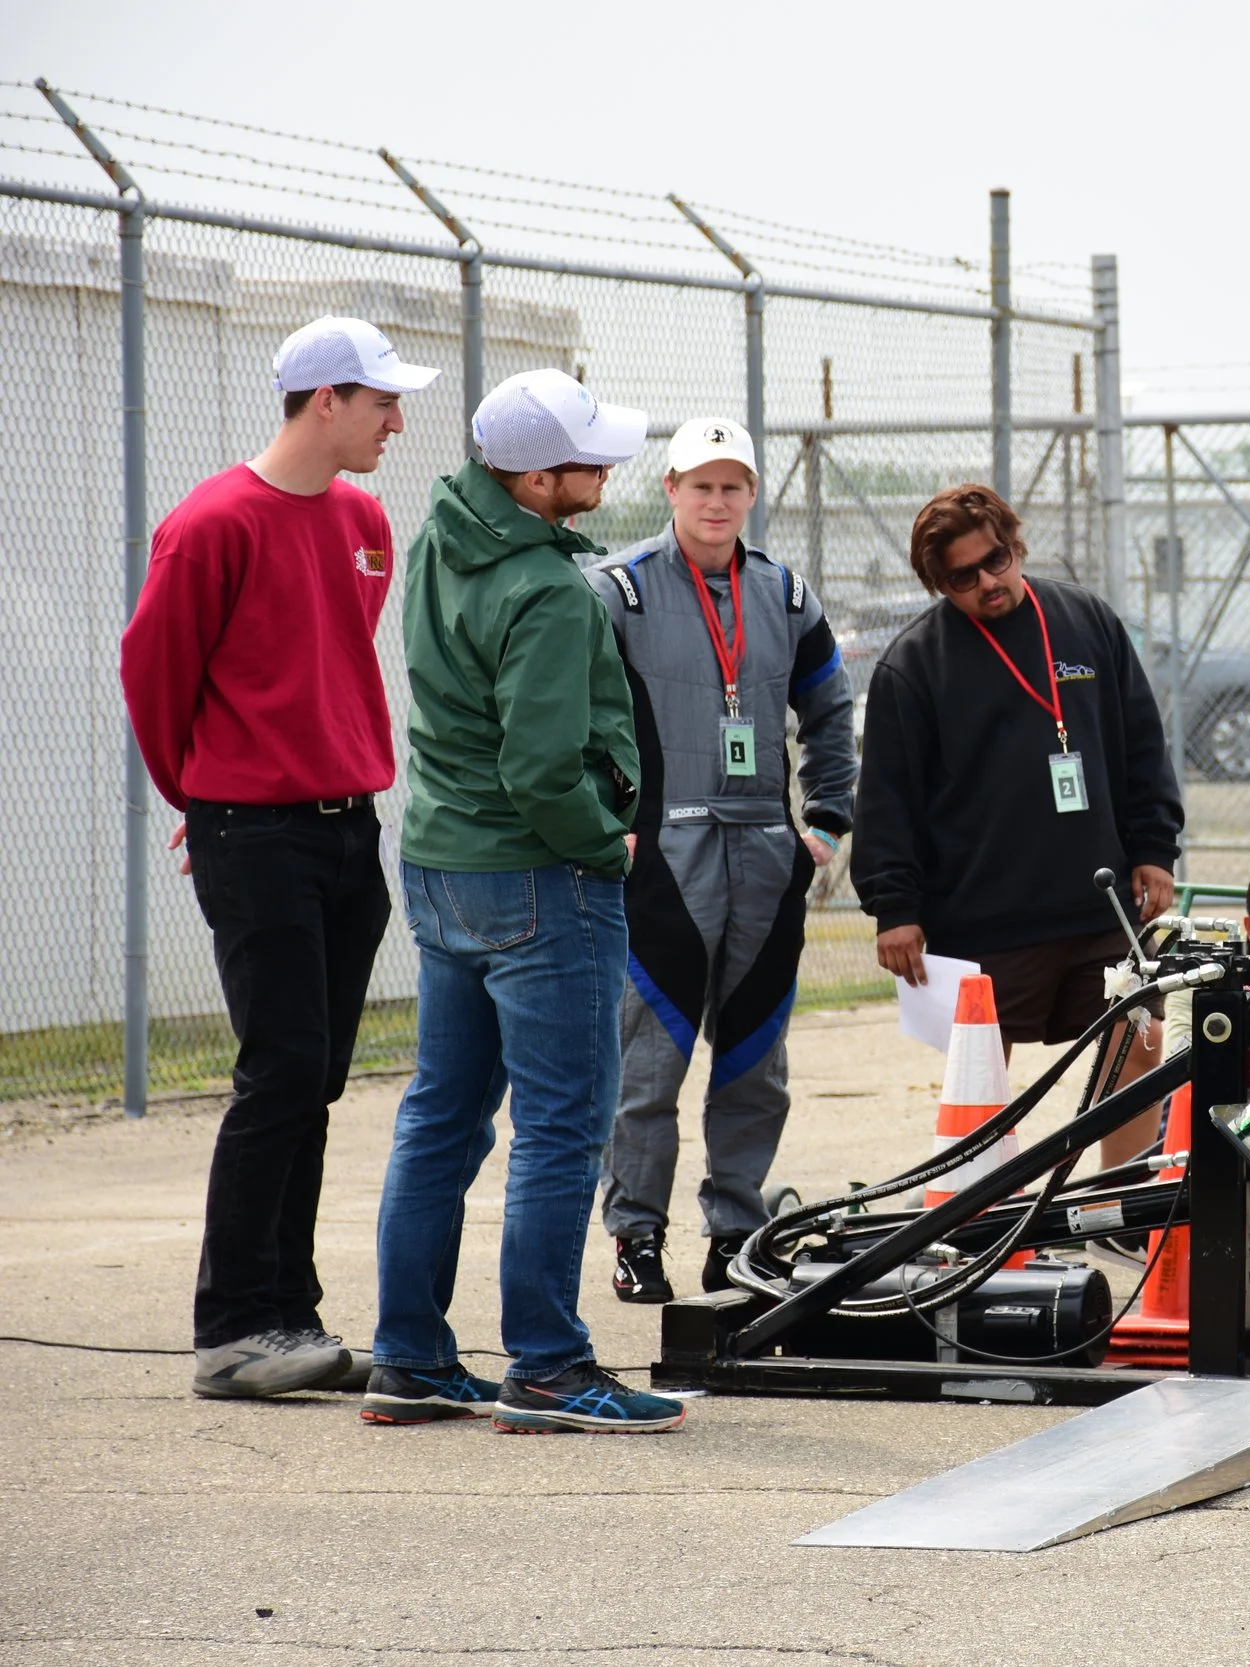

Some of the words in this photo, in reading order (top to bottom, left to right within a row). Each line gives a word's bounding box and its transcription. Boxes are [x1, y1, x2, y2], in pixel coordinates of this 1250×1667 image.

[734, 746, 741, 760] 1
[1062, 781, 1072, 795] 2
[669, 806, 708, 819] sparco
